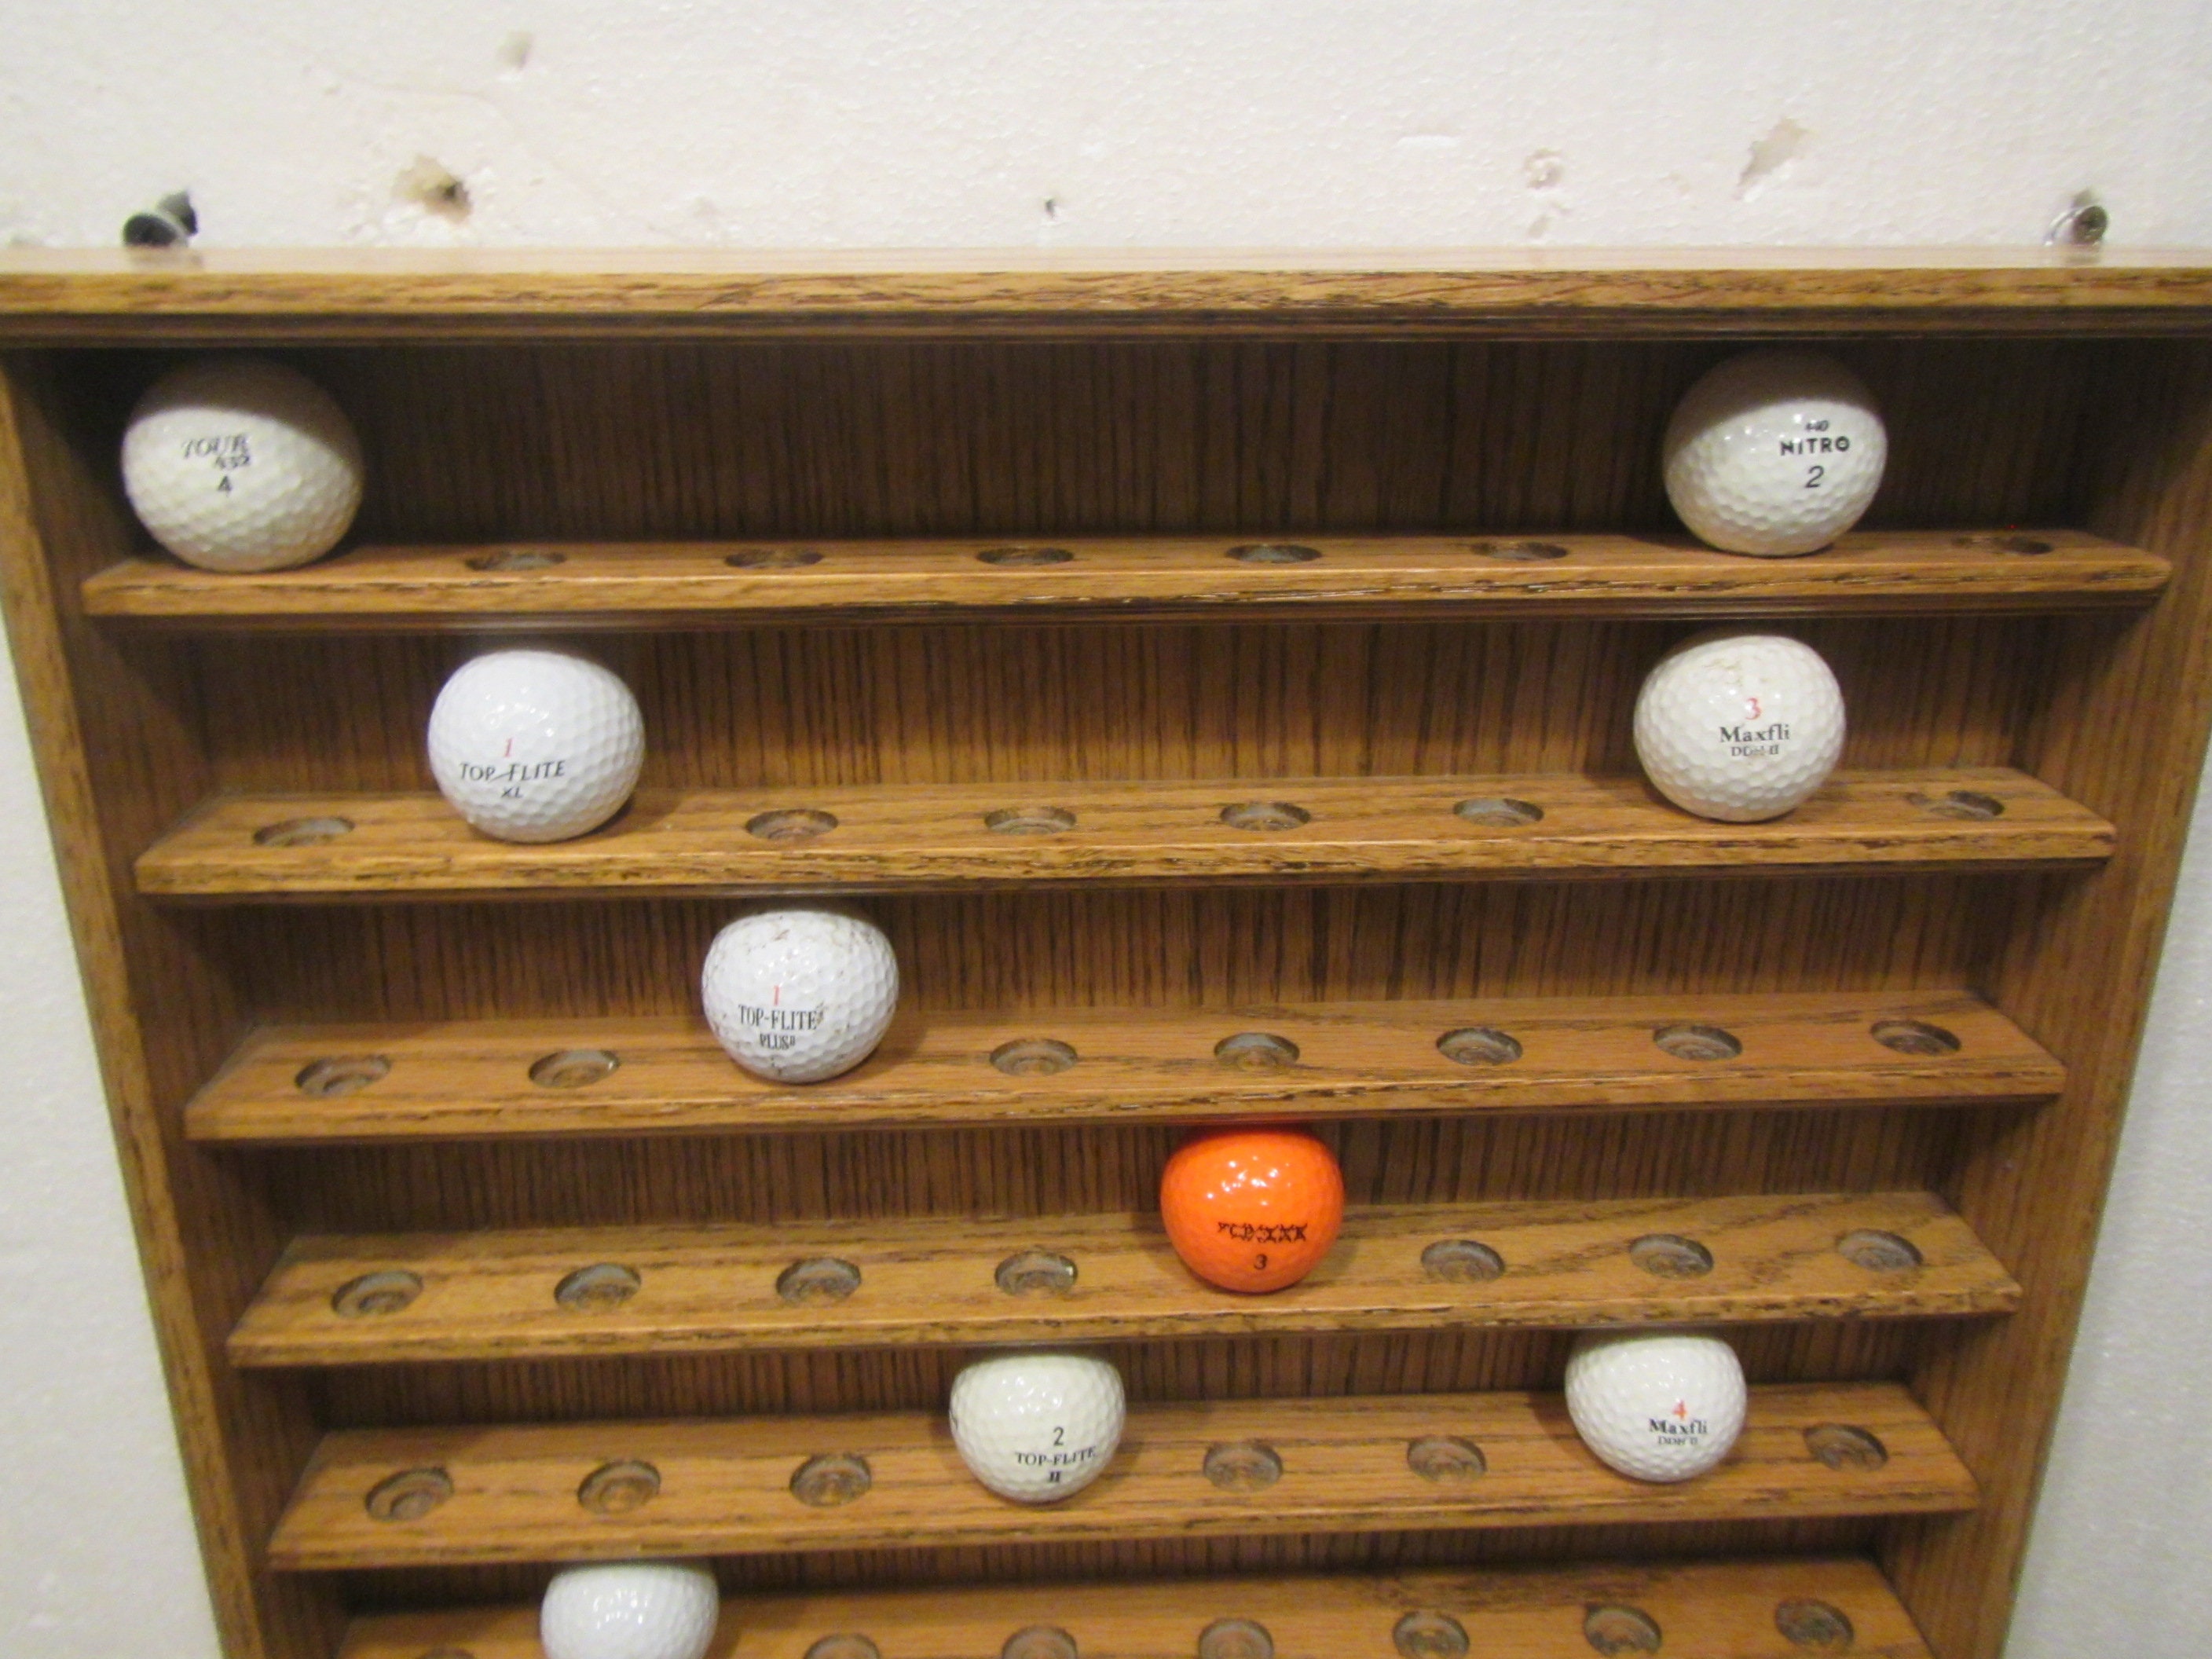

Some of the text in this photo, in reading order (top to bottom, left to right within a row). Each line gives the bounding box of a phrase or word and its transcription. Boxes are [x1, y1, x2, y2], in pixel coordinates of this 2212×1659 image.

[1780, 435, 1850, 456] NITRO
[1805, 465, 1824, 488] 2
[1745, 697, 1762, 720] 3
[1719, 723, 1790, 743] Maxfli
[501, 786, 524, 798] XL
[738, 1004, 818, 1031] TOP-FLITE
[1254, 1253, 1268, 1270] 3
[1672, 1399, 1688, 1421] 4
[1053, 1426, 1064, 1446] 2
[1649, 1418, 1708, 1434] Maxfli
